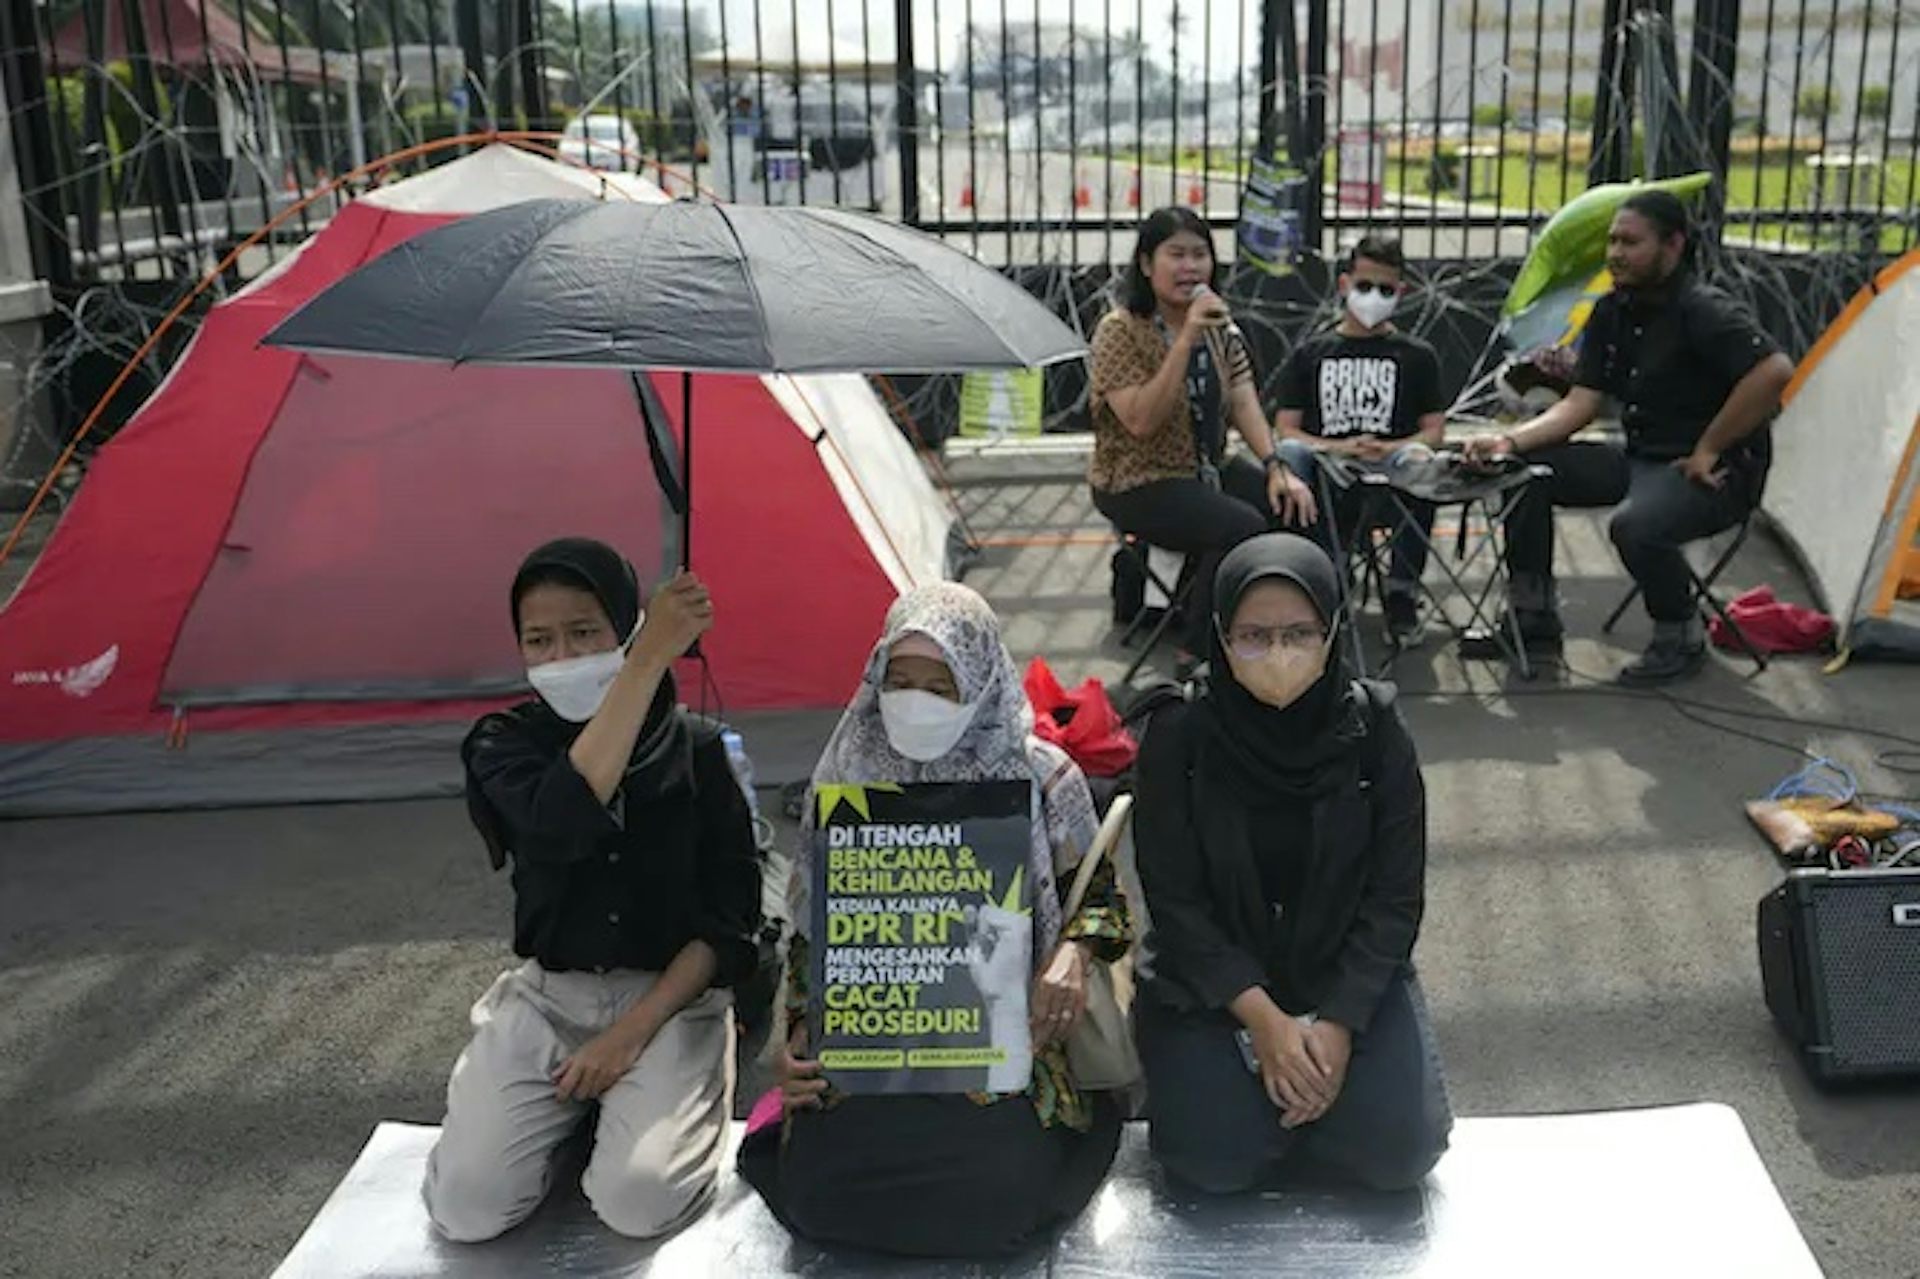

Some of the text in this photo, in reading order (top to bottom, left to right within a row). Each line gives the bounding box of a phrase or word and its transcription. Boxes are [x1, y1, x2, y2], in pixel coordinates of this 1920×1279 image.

[1321, 358, 1396, 387] BRING
[1321, 384, 1396, 419] BACK
[829, 825, 961, 847] DI TENGAH
[829, 847, 976, 870] BENCANA &
[828, 871, 993, 892] KEHILANGAN
[827, 898, 960, 913] KEDUA KALINYA
[828, 913, 948, 944] DPR RI
[826, 948, 981, 966] MENGESAHKAN
[826, 967, 944, 984] PERATURAN
[825, 985, 920, 1009] CACAT
[824, 1009, 980, 1035] PROSEDUR!
